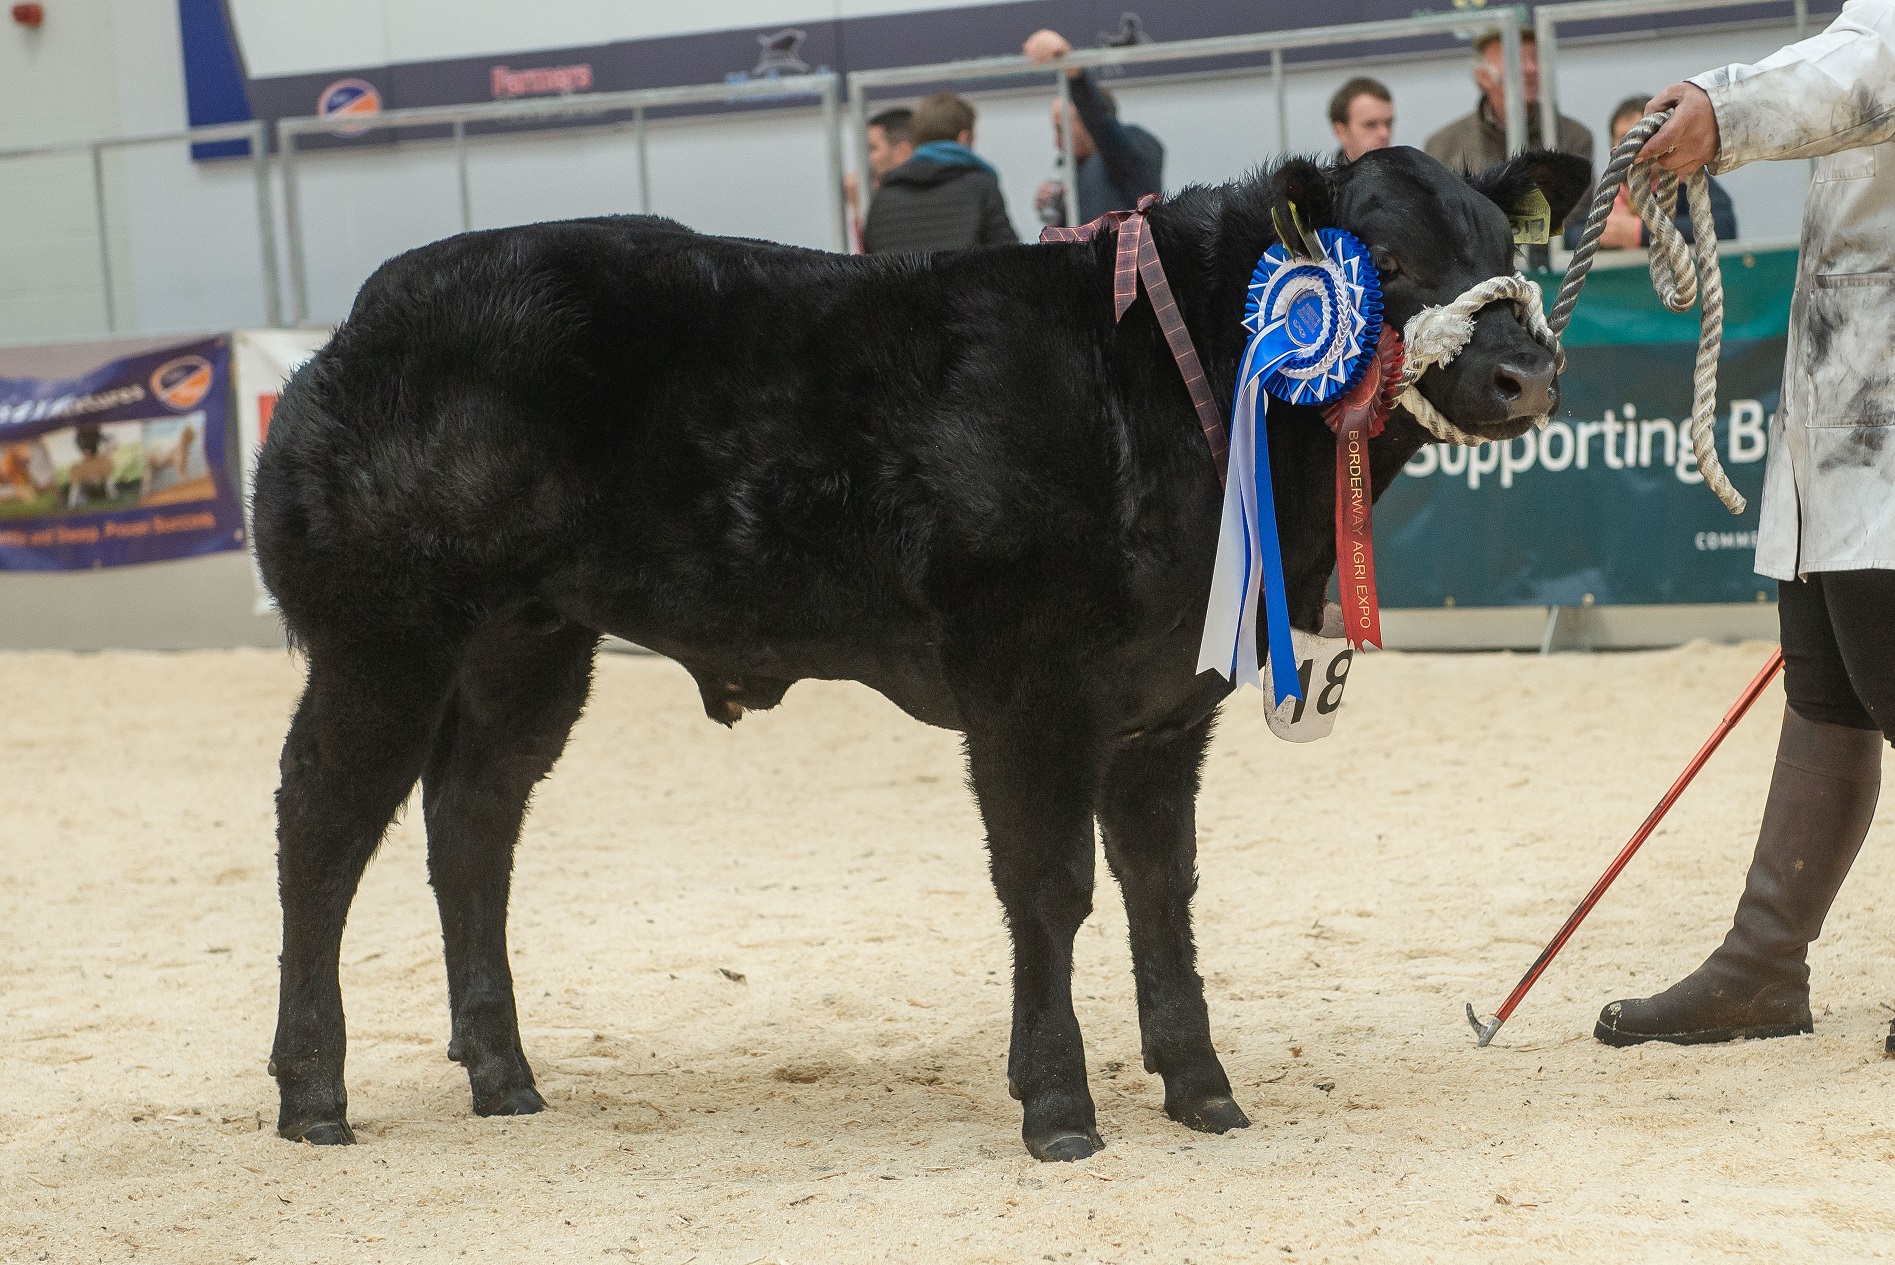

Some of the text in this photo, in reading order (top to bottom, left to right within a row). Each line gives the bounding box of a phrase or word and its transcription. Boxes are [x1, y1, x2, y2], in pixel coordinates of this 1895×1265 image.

[1404, 399, 1775, 489] Supporting B
[1348, 430, 1371, 629] BORDERWAY AGRI EXPO
[1290, 649, 1354, 724] 18
